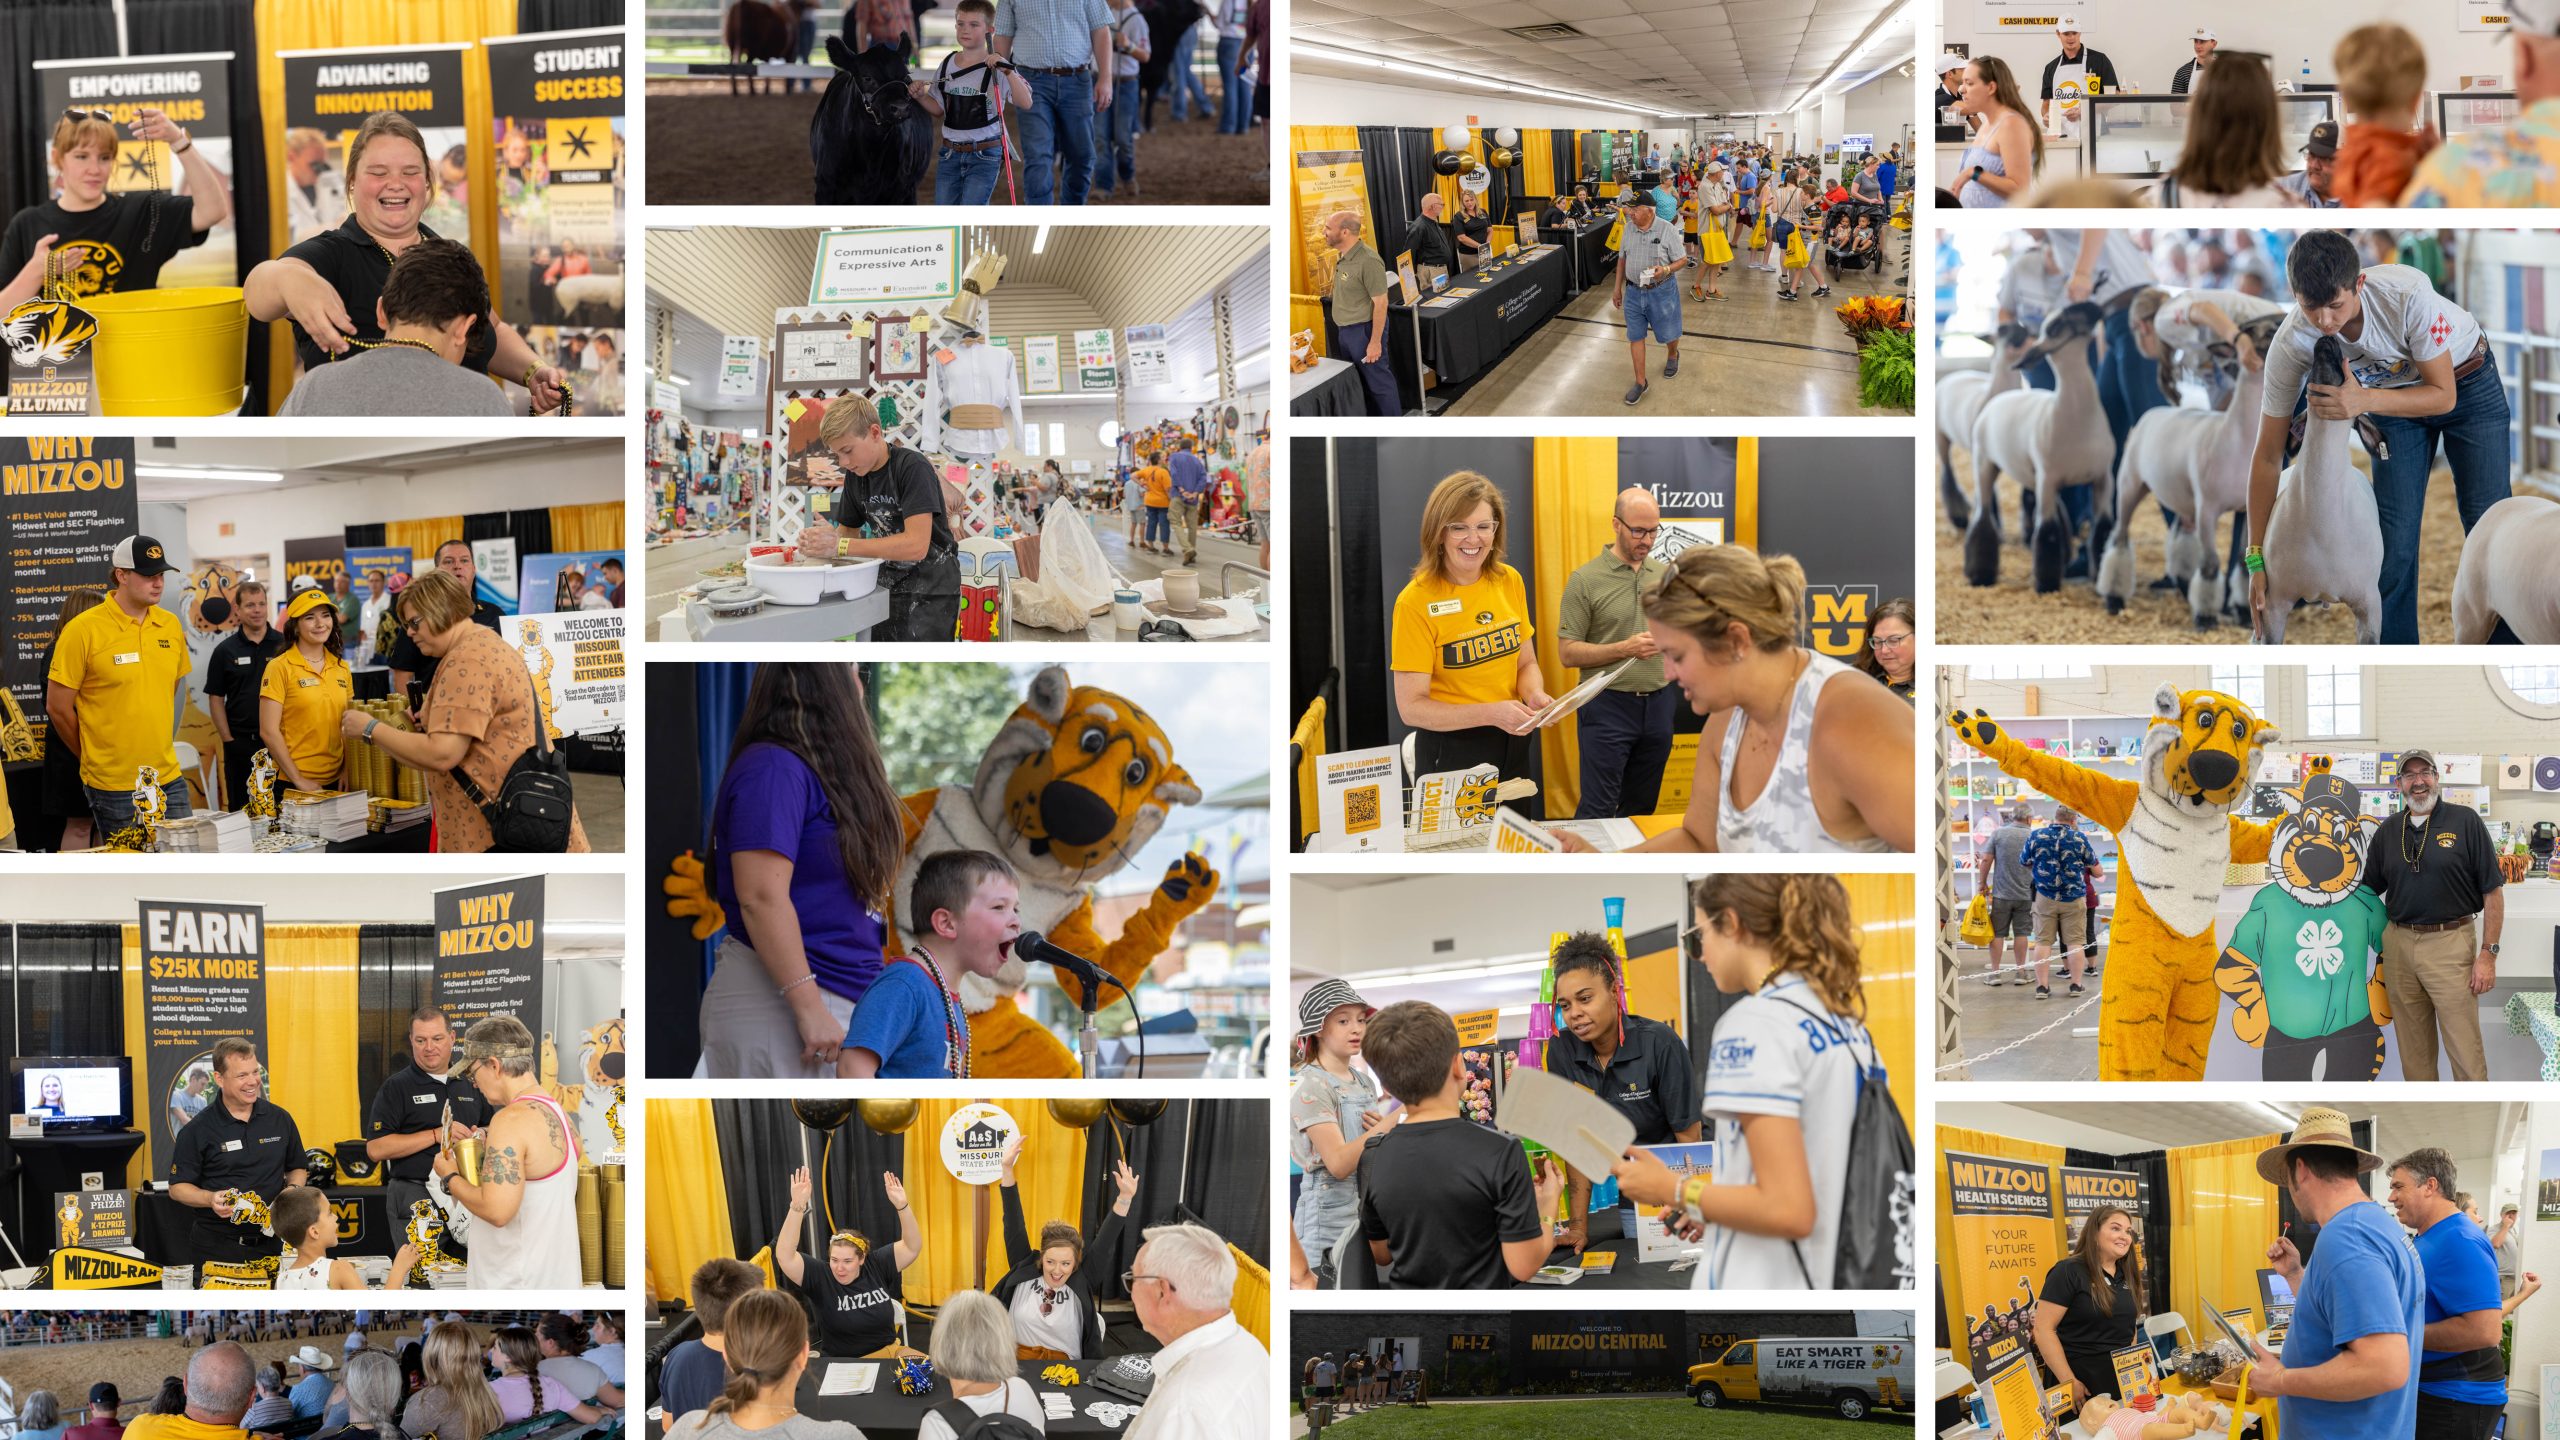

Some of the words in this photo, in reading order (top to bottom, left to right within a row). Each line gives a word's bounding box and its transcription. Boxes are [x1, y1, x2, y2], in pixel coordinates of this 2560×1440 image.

[2004, 17, 2022, 25] CASH
[2485, 16, 2502, 24] CASH
[534, 45, 622, 73] STUDENT
[316, 61, 430, 87] ADVANCING
[69, 71, 201, 98] EMPOWERING
[534, 75, 623, 102] SUCCESS
[315, 89, 433, 115] INNOVATION
[834, 244, 932, 257] Communication
[936, 243, 944, 251] &
[839, 260, 906, 271] Expressive
[910, 258, 937, 267] Arts
[1086, 370, 1110, 378] Stone
[12, 382, 88, 396] MIZZOU
[1084, 380, 1114, 388] County
[9, 398, 87, 412] ALUMNI
[27, 437, 95, 461] WHY
[3, 458, 125, 496] MIZZOU
[24, 512, 42, 520] Best
[44, 511, 67, 519] Value
[68, 510, 98, 519] among
[12, 522, 47, 531] Midwest
[49, 521, 64, 529] and
[66, 519, 84, 527] SEC
[85, 517, 125, 527] Flagships
[33, 547, 42, 556] of
[44, 546, 73, 555] Mizzou
[75, 544, 99, 554] grads
[14, 559, 41, 567] career
[42, 557, 74, 566] success
[76, 554, 102, 563] within
[103, 554, 109, 562] 6
[14, 568, 46, 577] months
[15, 585, 60, 595] Real-world
[16, 596, 49, 605] starting
[17, 614, 34, 622] 75%
[563, 617, 609, 631] WELCOME
[610, 616, 623, 627] TO
[554, 630, 591, 643] MIZZOU
[18, 642, 32, 650] the
[574, 640, 620, 654] MISSOURI
[19, 652, 33, 660] the
[575, 654, 603, 668] STATE
[603, 653, 624, 665] FAIR
[574, 667, 625, 682] ATTENDEES
[564, 687, 578, 696] Scan
[578, 686, 587, 695] the
[587, 685, 596, 694] QR
[596, 684, 609, 693] code
[577, 693, 587, 701] out
[587, 692, 600, 700] more
[600, 690, 617, 699] about
[1327, 763, 1345, 773] SCAN
[1346, 762, 1354, 770] TO
[1354, 759, 1374, 769] LEARN
[1375, 756, 1392, 765] MORE
[1328, 771, 1345, 780] ABOUT
[1346, 768, 1366, 777] MAKING
[1374, 763, 1392, 771] IMPACT
[459, 891, 514, 926] WHY
[147, 909, 258, 955] EARN
[439, 920, 534, 957] MIZZOU
[149, 955, 202, 980] $25K
[204, 958, 259, 979] MORE
[487, 968, 510, 976] among
[443, 979, 469, 987] Midwest
[499, 974, 531, 983] Flagships
[151, 985, 178, 993] Recent
[180, 985, 207, 993] Mizzou
[209, 986, 231, 994] grads
[211, 997, 228, 1005] year
[466, 1001, 489, 1009] Mizzou
[490, 1000, 508, 1008] grads
[206, 1005, 222, 1014] only
[230, 1006, 248, 1014] high
[153, 1014, 178, 1022] school
[179, 1015, 212, 1024] diploma.
[153, 1028, 183, 1037] College
[154, 1039, 172, 1047] your
[173, 1038, 199, 1046] future.
[969, 1130, 993, 1143] A&S
[960, 1160, 984, 1168] STATE
[1952, 1161, 2046, 1193] MIZZOU
[2065, 1175, 2137, 1198] MIZZOU
[92, 1193, 114, 1202] WIN
[116, 1192, 124, 1201] A
[1955, 1190, 2000, 1205] HEALTH
[2000, 1193, 2048, 1207] SCIENCES
[2067, 1197, 2100, 1208] HEALTH
[90, 1200, 126, 1210] PRIZE!
[94, 1211, 123, 1221] MIZZOU
[91, 1220, 106, 1230] K-12
[106, 1220, 127, 1229] PRIZE
[92, 1228, 126, 1238] DRAWING
[1992, 1229, 2028, 1240] YOUR
[1986, 1243, 2036, 1255] FUTURE
[65, 1255, 158, 1281] MIZZOU-RAH
[1988, 1258, 2037, 1270] AWAITS
[1452, 1336, 1490, 1351] M-I-Z
[1531, 1334, 1596, 1351] MIZZOU
[1599, 1333, 1667, 1350] CENTRAL
[1987, 1335, 2018, 1360] MIZZOU
[1776, 1347, 1804, 1358] EAT
[1807, 1346, 1864, 1358] SMART
[1776, 1359, 1806, 1369] LIKE
[1808, 1359, 1819, 1369] A
[1823, 1360, 1866, 1370] TIGER
